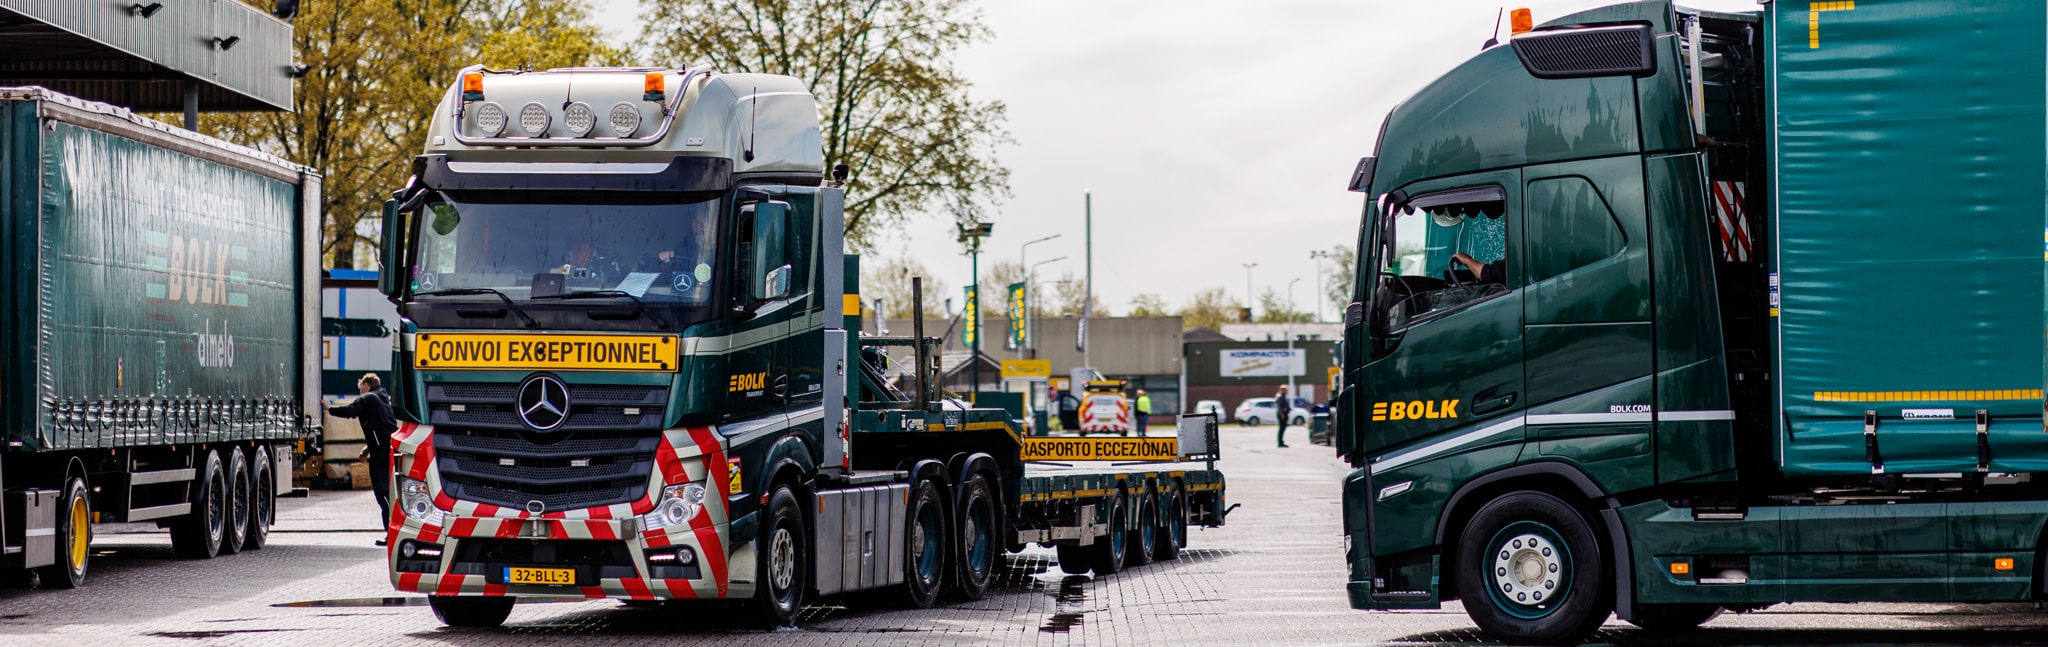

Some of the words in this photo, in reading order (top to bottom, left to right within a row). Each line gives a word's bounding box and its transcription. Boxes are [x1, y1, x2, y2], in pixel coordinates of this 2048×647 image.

[168, 234, 230, 305] BOLK
[198, 318, 235, 368] almelo
[428, 340, 501, 362] CONVOI
[508, 341, 663, 364] EXCEPTIONNEL
[737, 372, 767, 392] BOLK
[1389, 399, 1460, 421] BOLK
[1610, 404, 1651, 413] BOLK.COM
[1024, 441, 1091, 457] RASPORTO
[1095, 442, 1178, 457] ECCEZIONAL
[515, 569, 570, 583] 32-BLL-3
